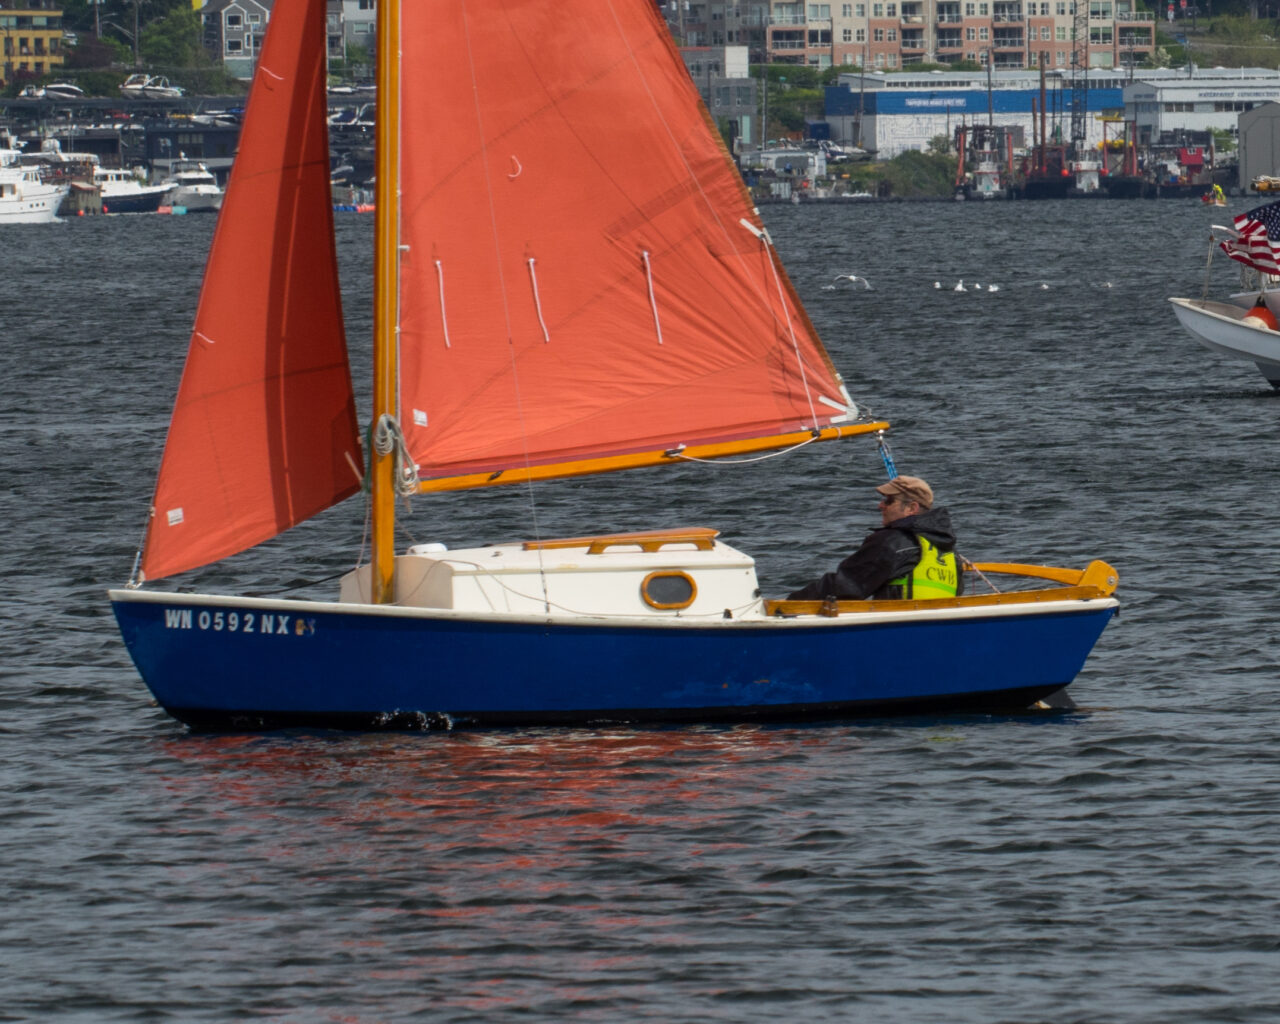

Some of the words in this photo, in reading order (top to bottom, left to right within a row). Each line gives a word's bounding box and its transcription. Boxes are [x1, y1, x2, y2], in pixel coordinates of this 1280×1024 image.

[165, 609, 192, 629] WN
[199, 611, 255, 633] 0592
[260, 615, 290, 635] NX
